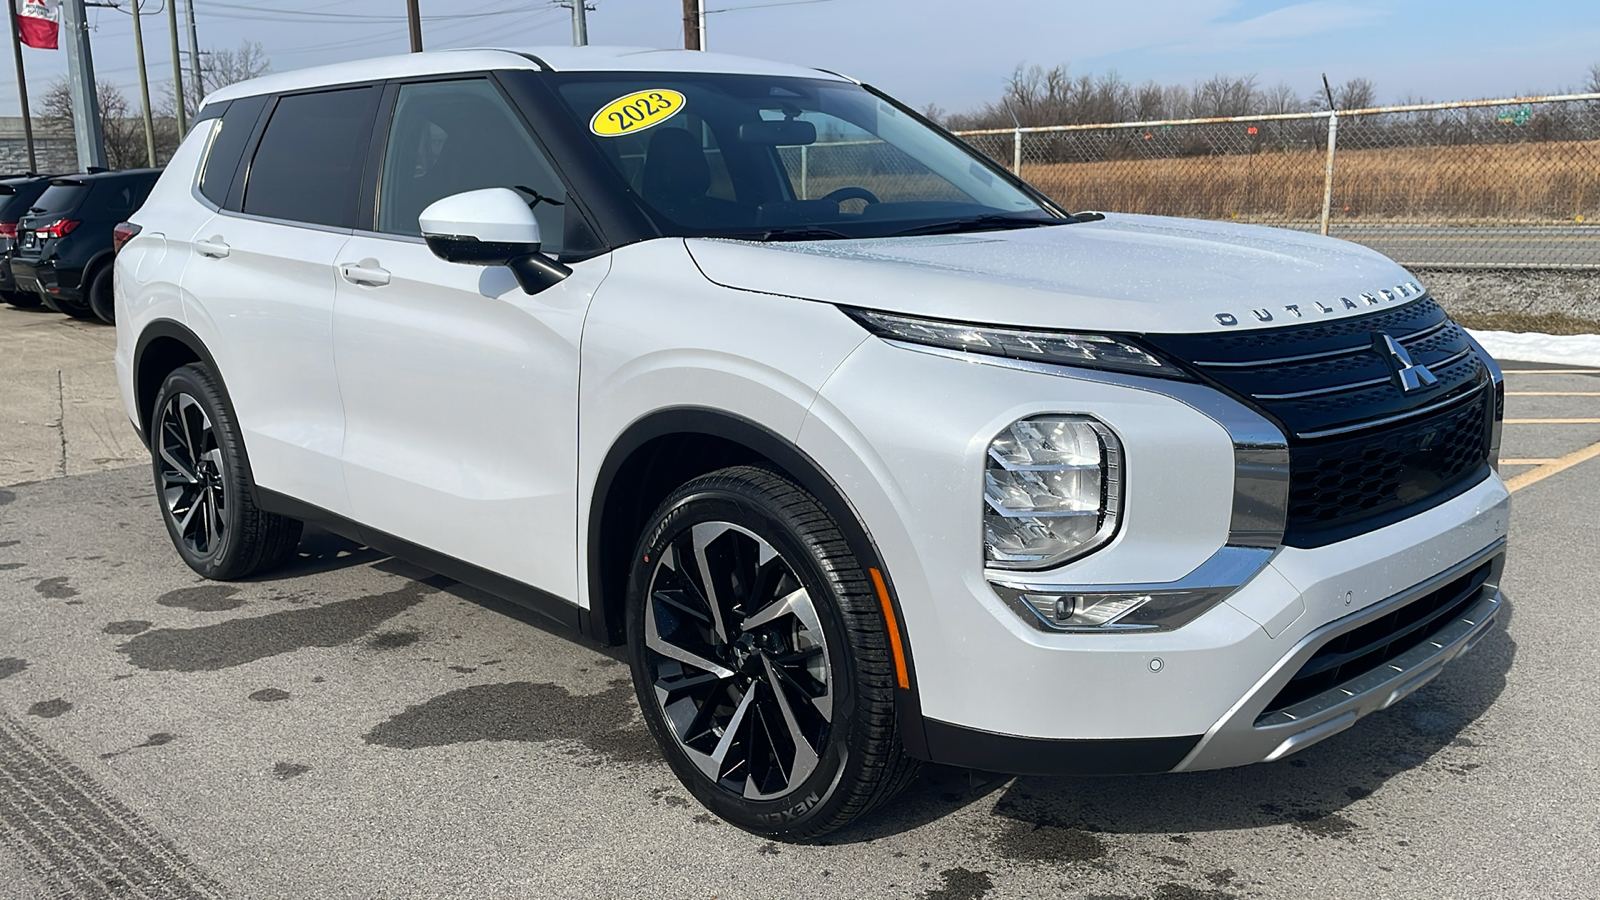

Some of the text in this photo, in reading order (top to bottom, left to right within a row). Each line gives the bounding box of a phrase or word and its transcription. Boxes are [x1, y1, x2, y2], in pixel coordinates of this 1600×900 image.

[608, 93, 671, 130] 2023
[1214, 282, 1421, 326] OUTLANDER
[757, 791, 819, 823] NEXEN
